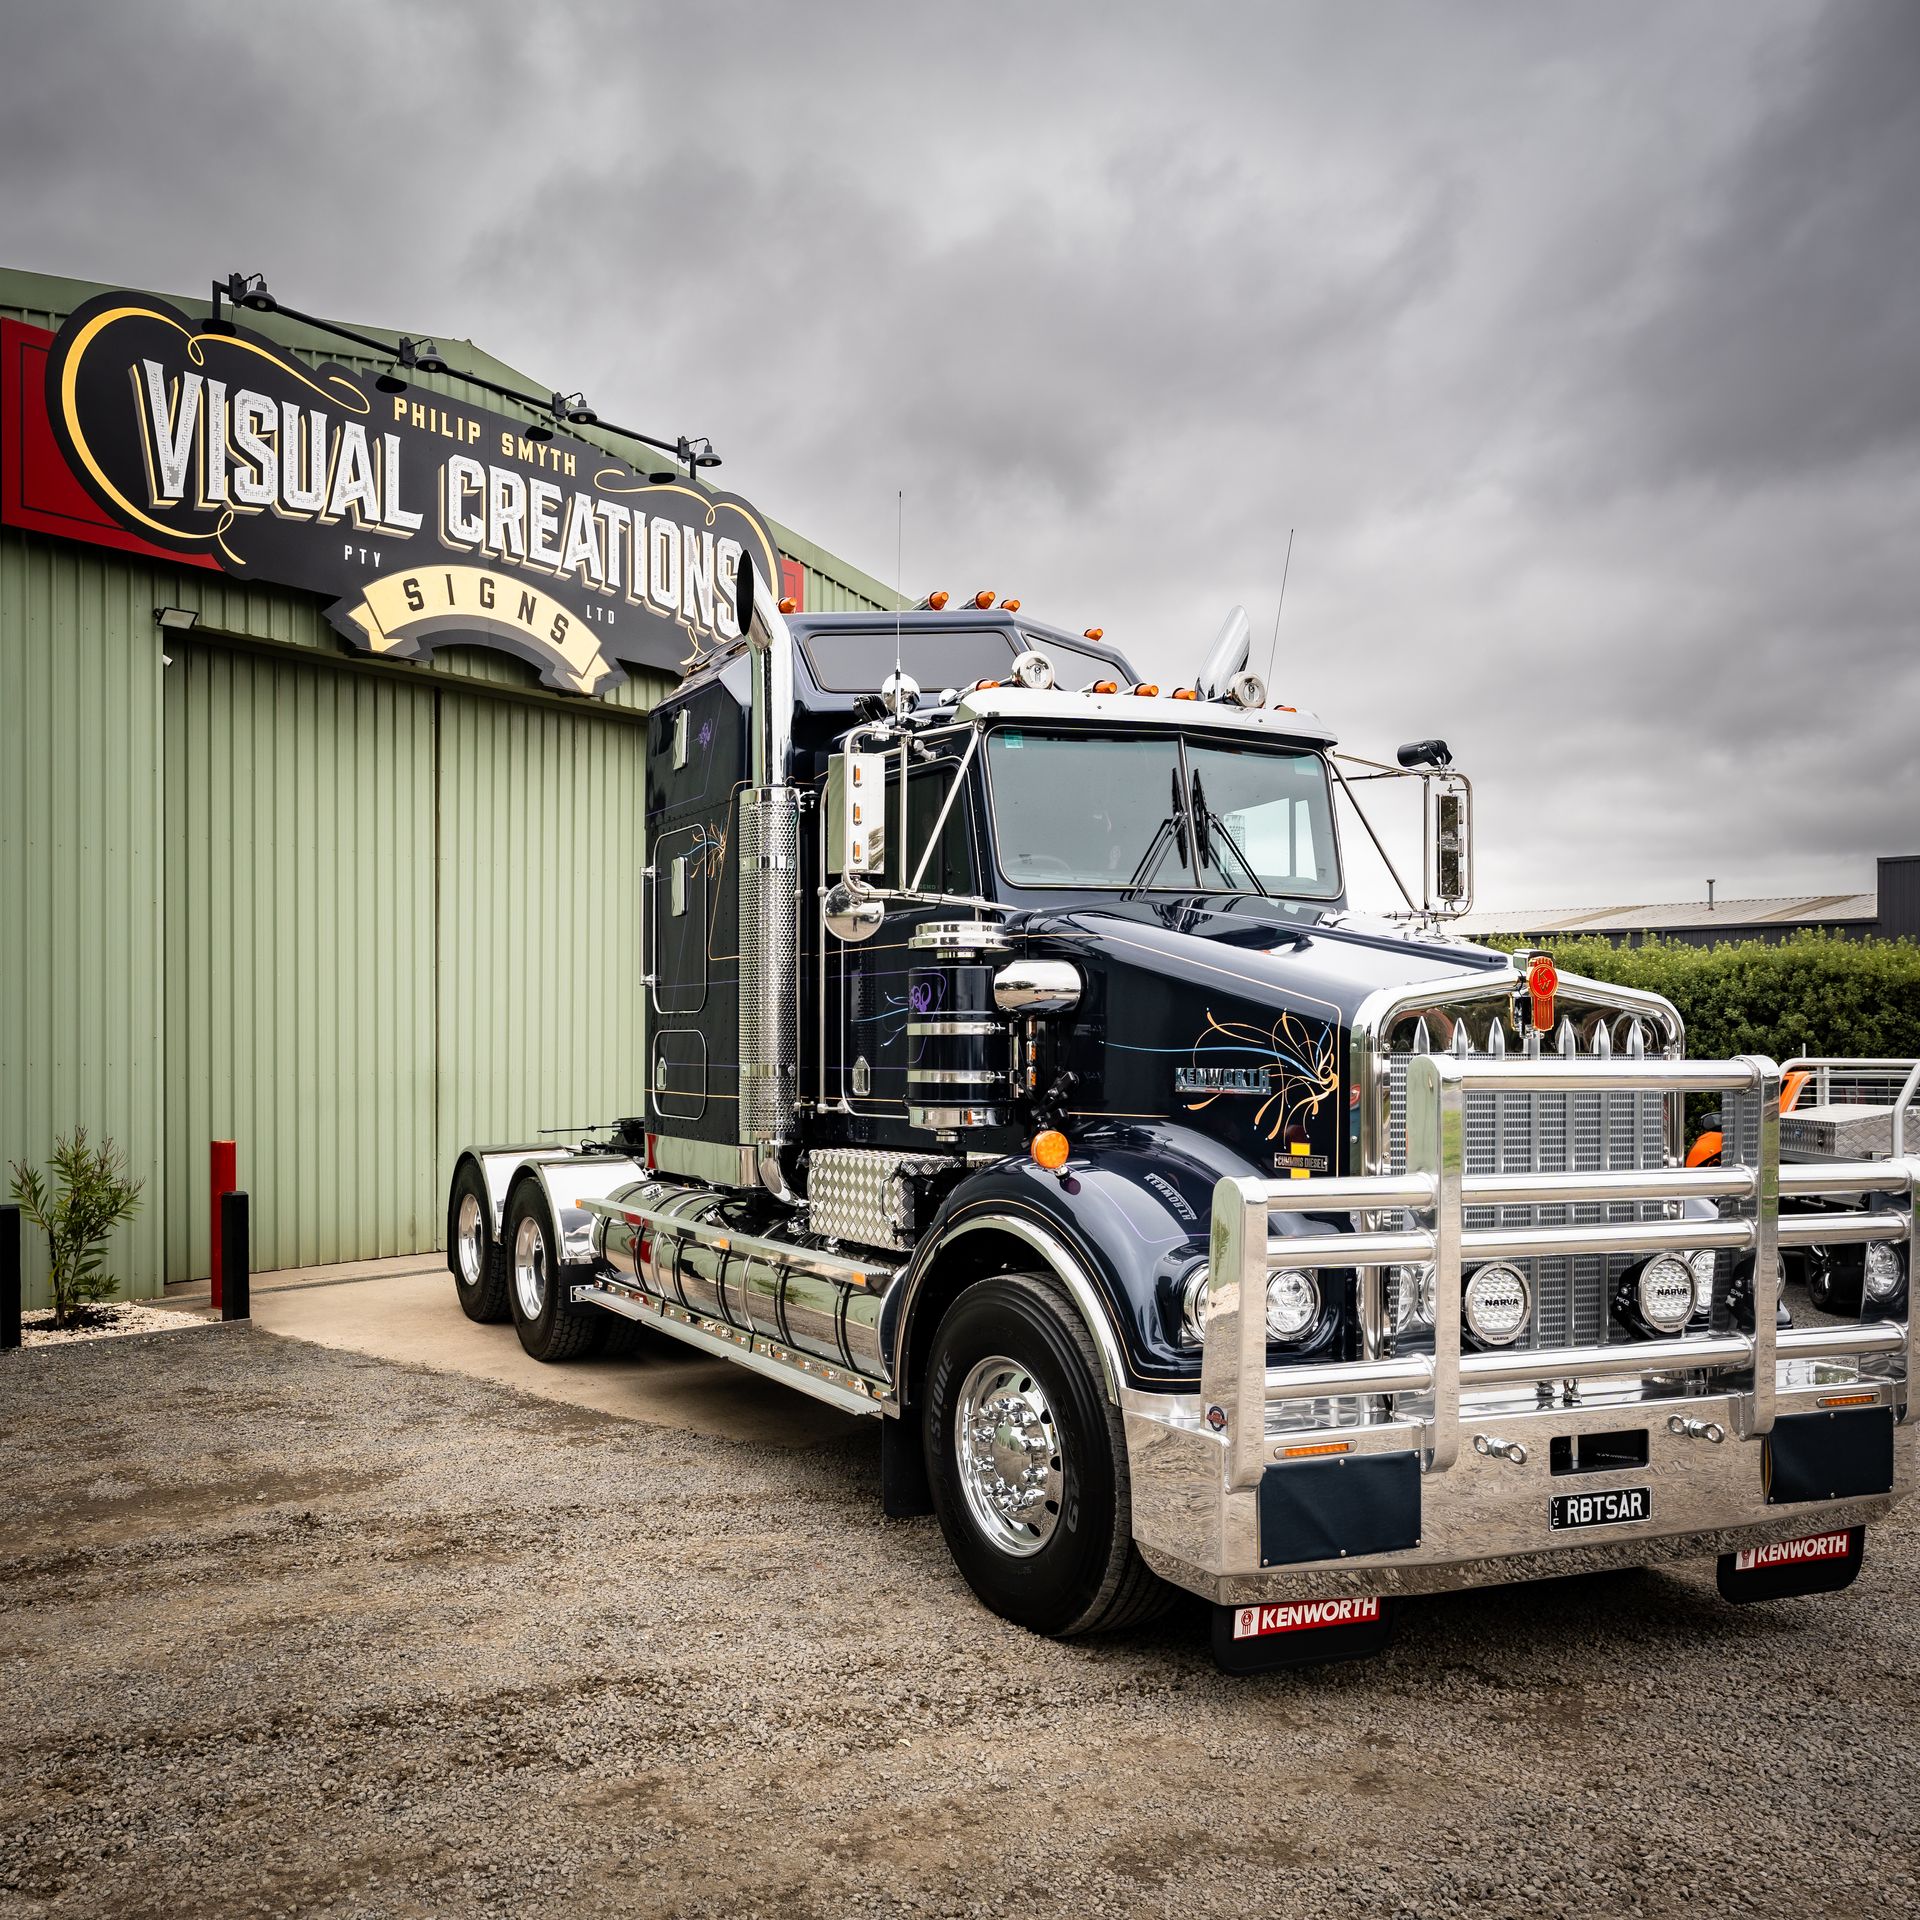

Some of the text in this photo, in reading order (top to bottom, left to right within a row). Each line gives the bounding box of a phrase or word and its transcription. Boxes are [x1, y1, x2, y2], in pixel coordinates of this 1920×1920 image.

[394, 396, 576, 477] PHILIP SMYTH
[143, 358, 743, 638] VISUAL CREATIONS
[344, 544, 381, 568] PTY
[402, 573, 570, 645] SIGNS
[587, 604, 615, 625] LTD
[1175, 1067, 1271, 1088] KENWORTH
[1304, 1157, 1325, 1169] DIESEL
[1657, 1288, 1688, 1296] NARVA
[1552, 1500, 1560, 1526] VIC
[1567, 1492, 1643, 1524] RBTSAR
[1758, 1534, 1848, 1564] KENWORTH
[1262, 1596, 1378, 1630] KENWORTH
